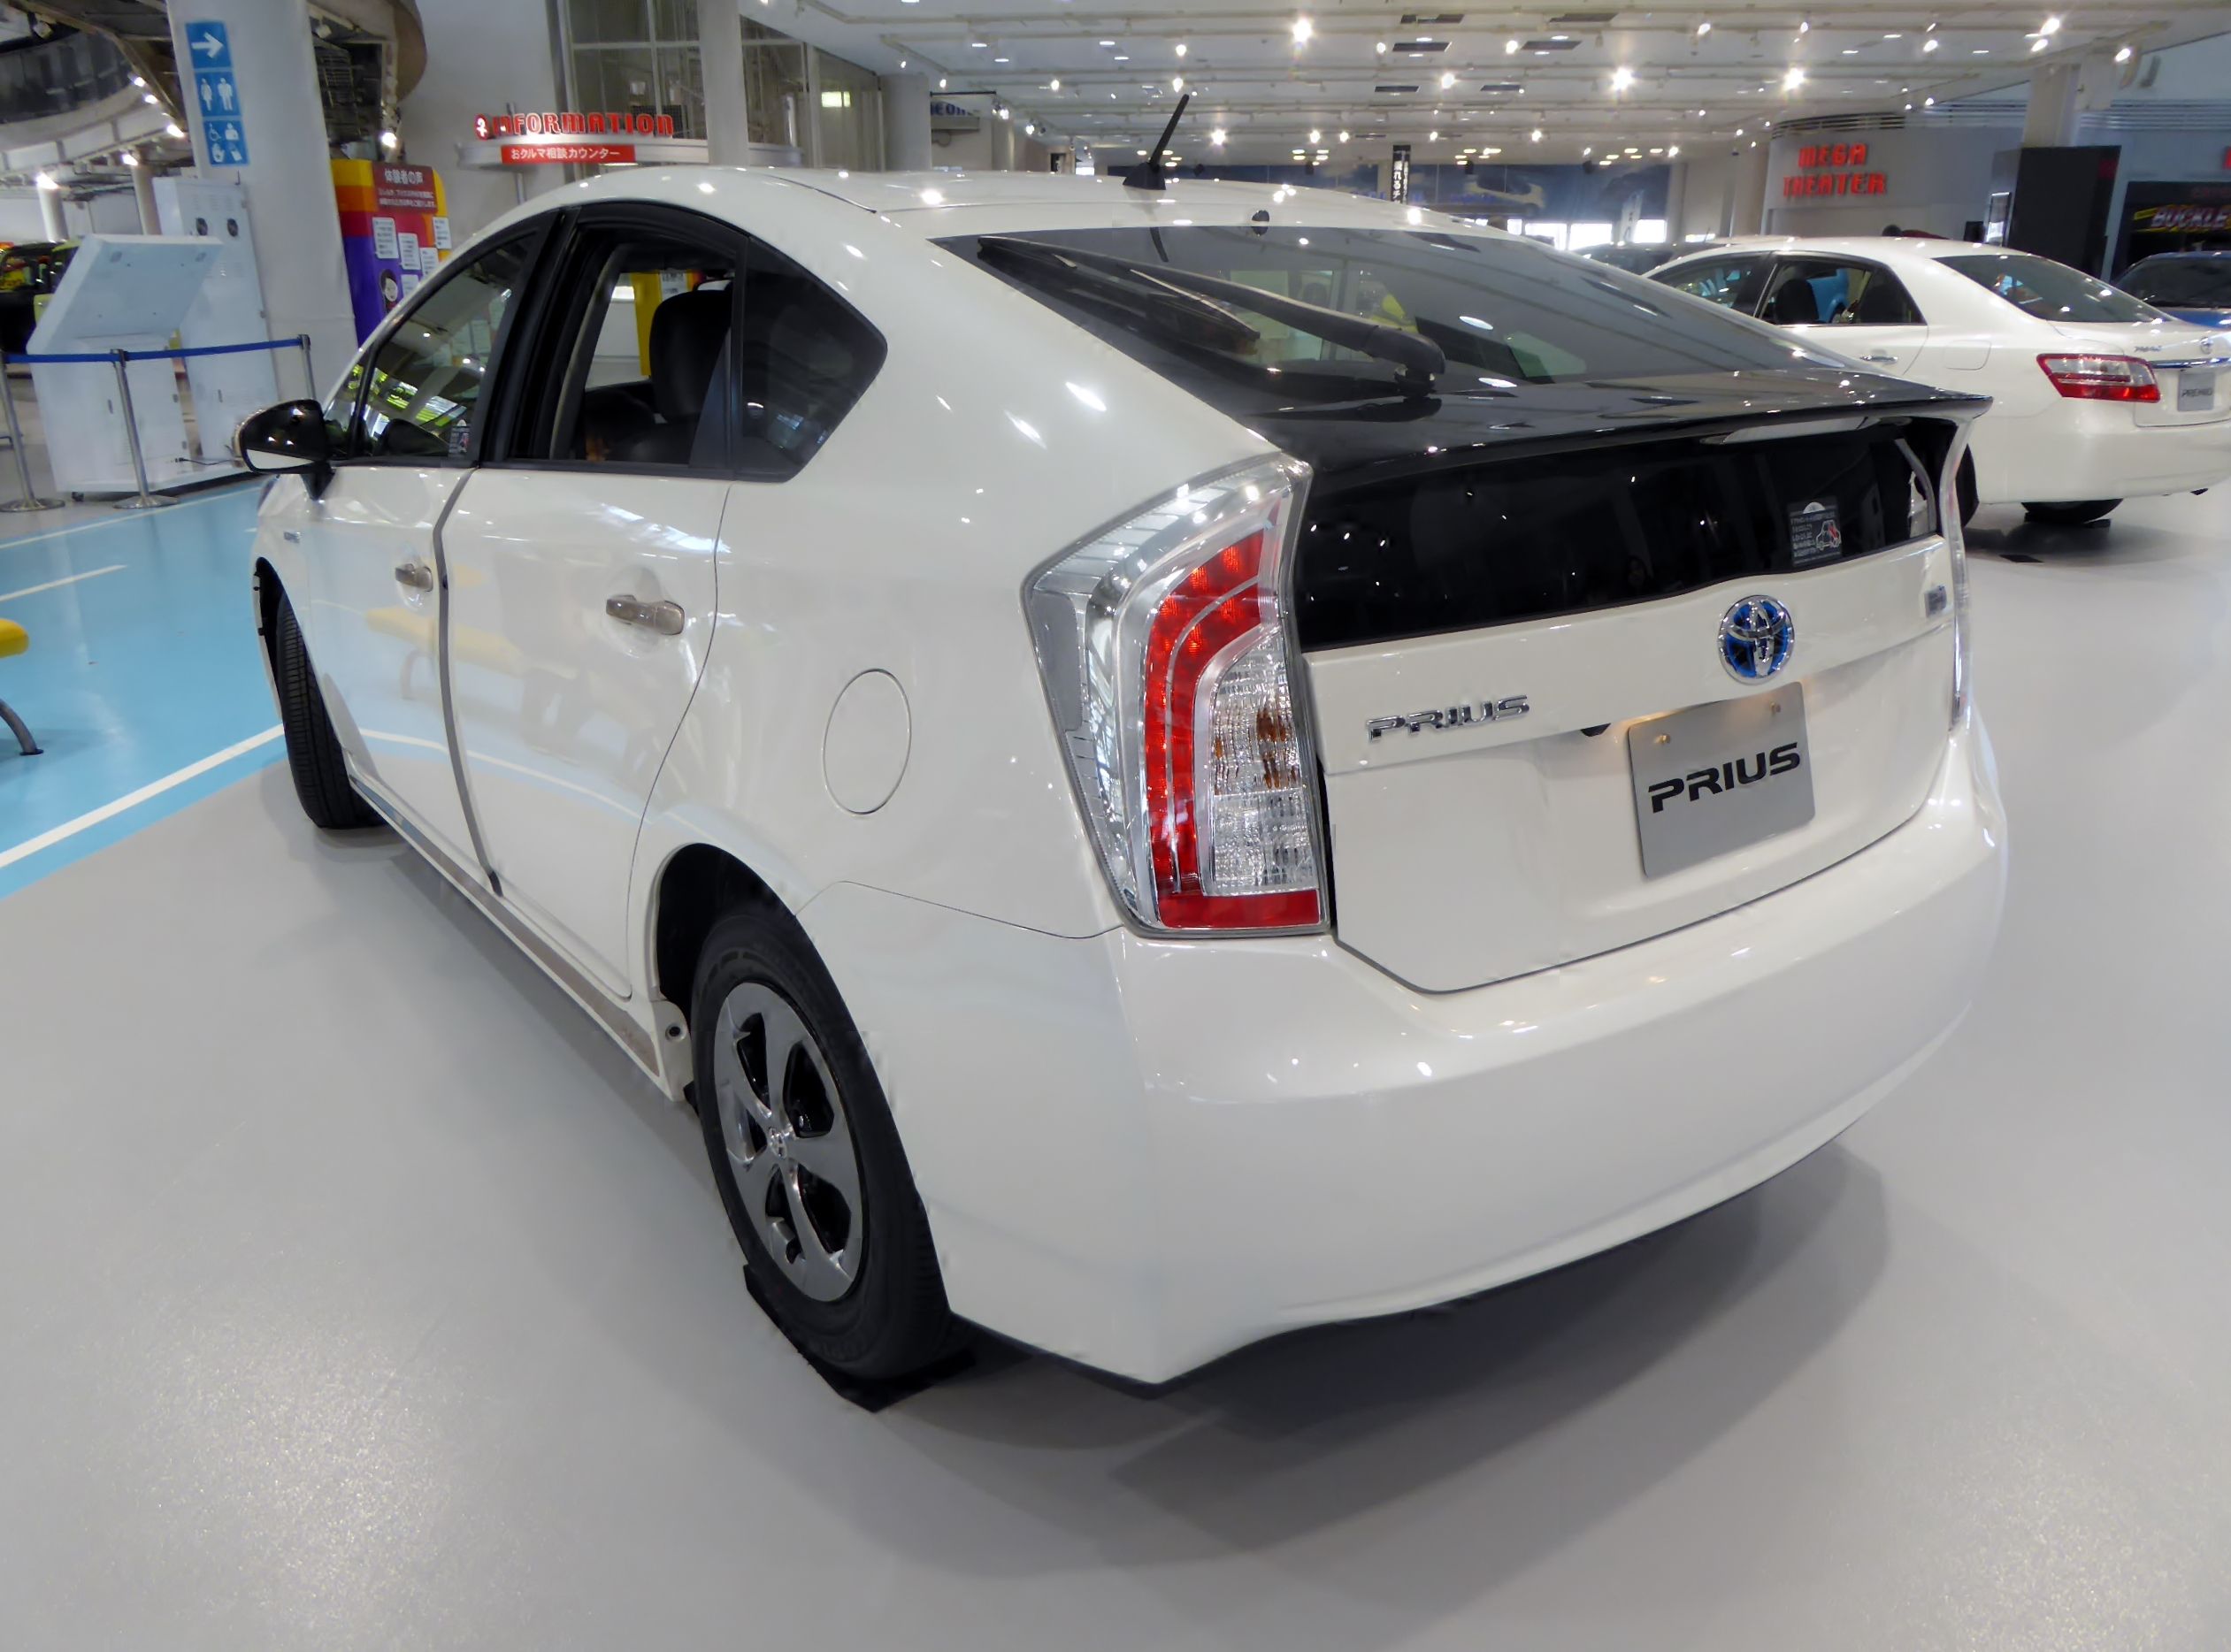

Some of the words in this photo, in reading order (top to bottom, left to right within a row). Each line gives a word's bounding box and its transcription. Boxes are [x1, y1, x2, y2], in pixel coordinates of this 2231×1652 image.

[493, 112, 674, 137] INFORMATION
[510, 147, 620, 160] おクルマ相談カウンター
[1798, 142, 1867, 169] MEGA
[1782, 172, 1886, 198] THEATER
[1367, 694, 1530, 743] PRIUS
[1647, 741, 1801, 814] PRIUS
